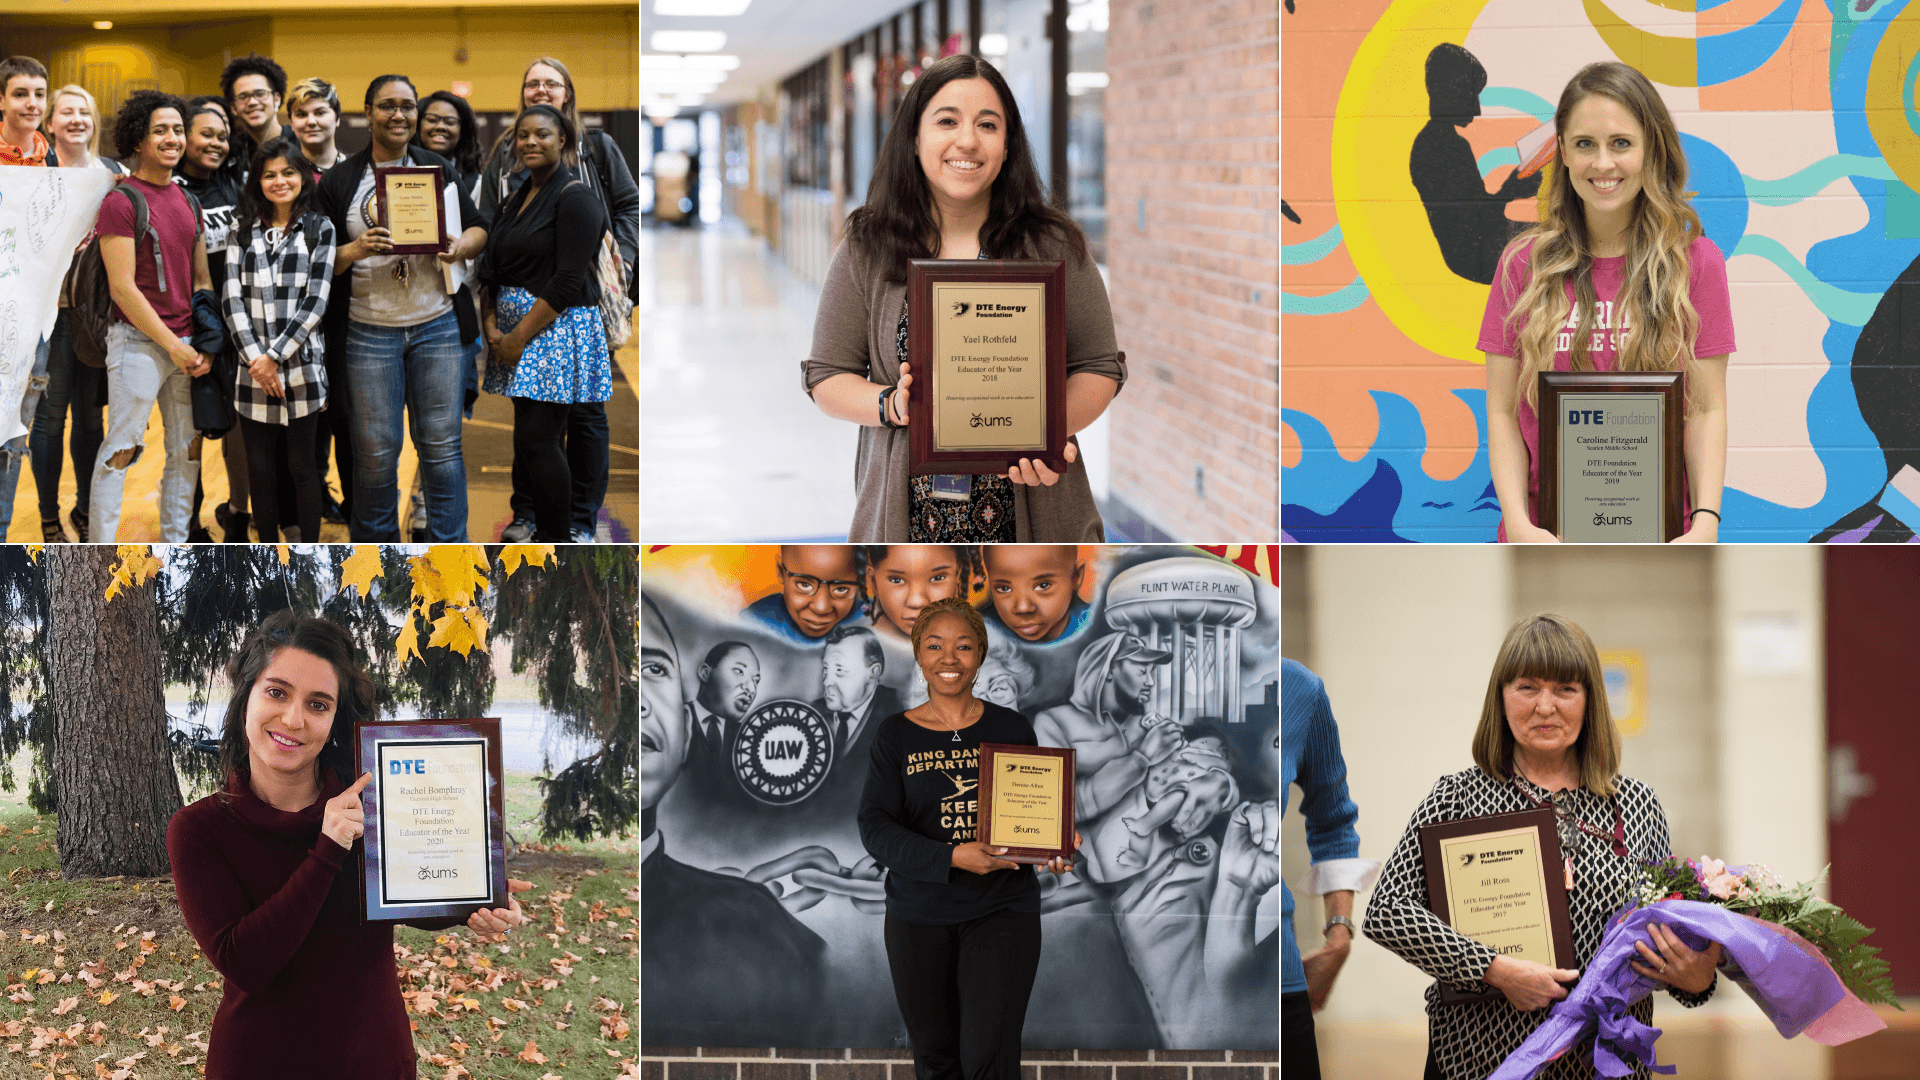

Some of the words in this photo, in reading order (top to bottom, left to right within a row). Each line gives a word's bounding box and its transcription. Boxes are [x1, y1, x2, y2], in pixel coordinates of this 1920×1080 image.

[996, 304, 1027, 312] Energy
[963, 335, 980, 344] Yael
[982, 335, 1017, 344] Rothfeld
[968, 355, 990, 363] Energy
[982, 374, 998, 382] 2018
[984, 416, 1012, 427] ums
[1569, 410, 1603, 425] DTE
[1606, 411, 1656, 425] Foundation
[1576, 436, 1609, 444] Caroline
[1610, 436, 1648, 446] Fitzgerald
[1607, 516, 1633, 525] ums
[1141, 582, 1168, 593] FLINT
[1171, 581, 1209, 592] WATER
[1212, 582, 1240, 594] PLANT
[765, 740, 804, 760] UAW
[908, 749, 946, 764] KING
[951, 748, 980, 759] DAN
[390, 759, 425, 775] DTE
[428, 761, 477, 774] Foundation
[906, 758, 979, 776] DEPARTM
[400, 787, 426, 795] Rachel
[428, 786, 466, 796] Bomphray
[1514, 778, 1543, 804] BEACON
[431, 808, 455, 816] Energy
[940, 800, 978, 814] KEE
[414, 817, 454, 825] Foundation
[940, 815, 977, 829] CAL
[399, 828, 430, 837] Educator
[432, 827, 441, 835] of
[441, 827, 452, 835] the
[454, 827, 470, 835] Year
[1582, 820, 1616, 842] BEACON
[1480, 851, 1495, 859] DTE
[1497, 848, 1524, 856] Energy
[1481, 856, 1513, 865] Foundation
[432, 868, 458, 878] ums
[1481, 878, 1491, 887] Jill
[1499, 891, 1531, 900] Foundation
[1470, 904, 1495, 913] Educator
[1492, 911, 1507, 919] 2017
[1498, 944, 1524, 955] ums
